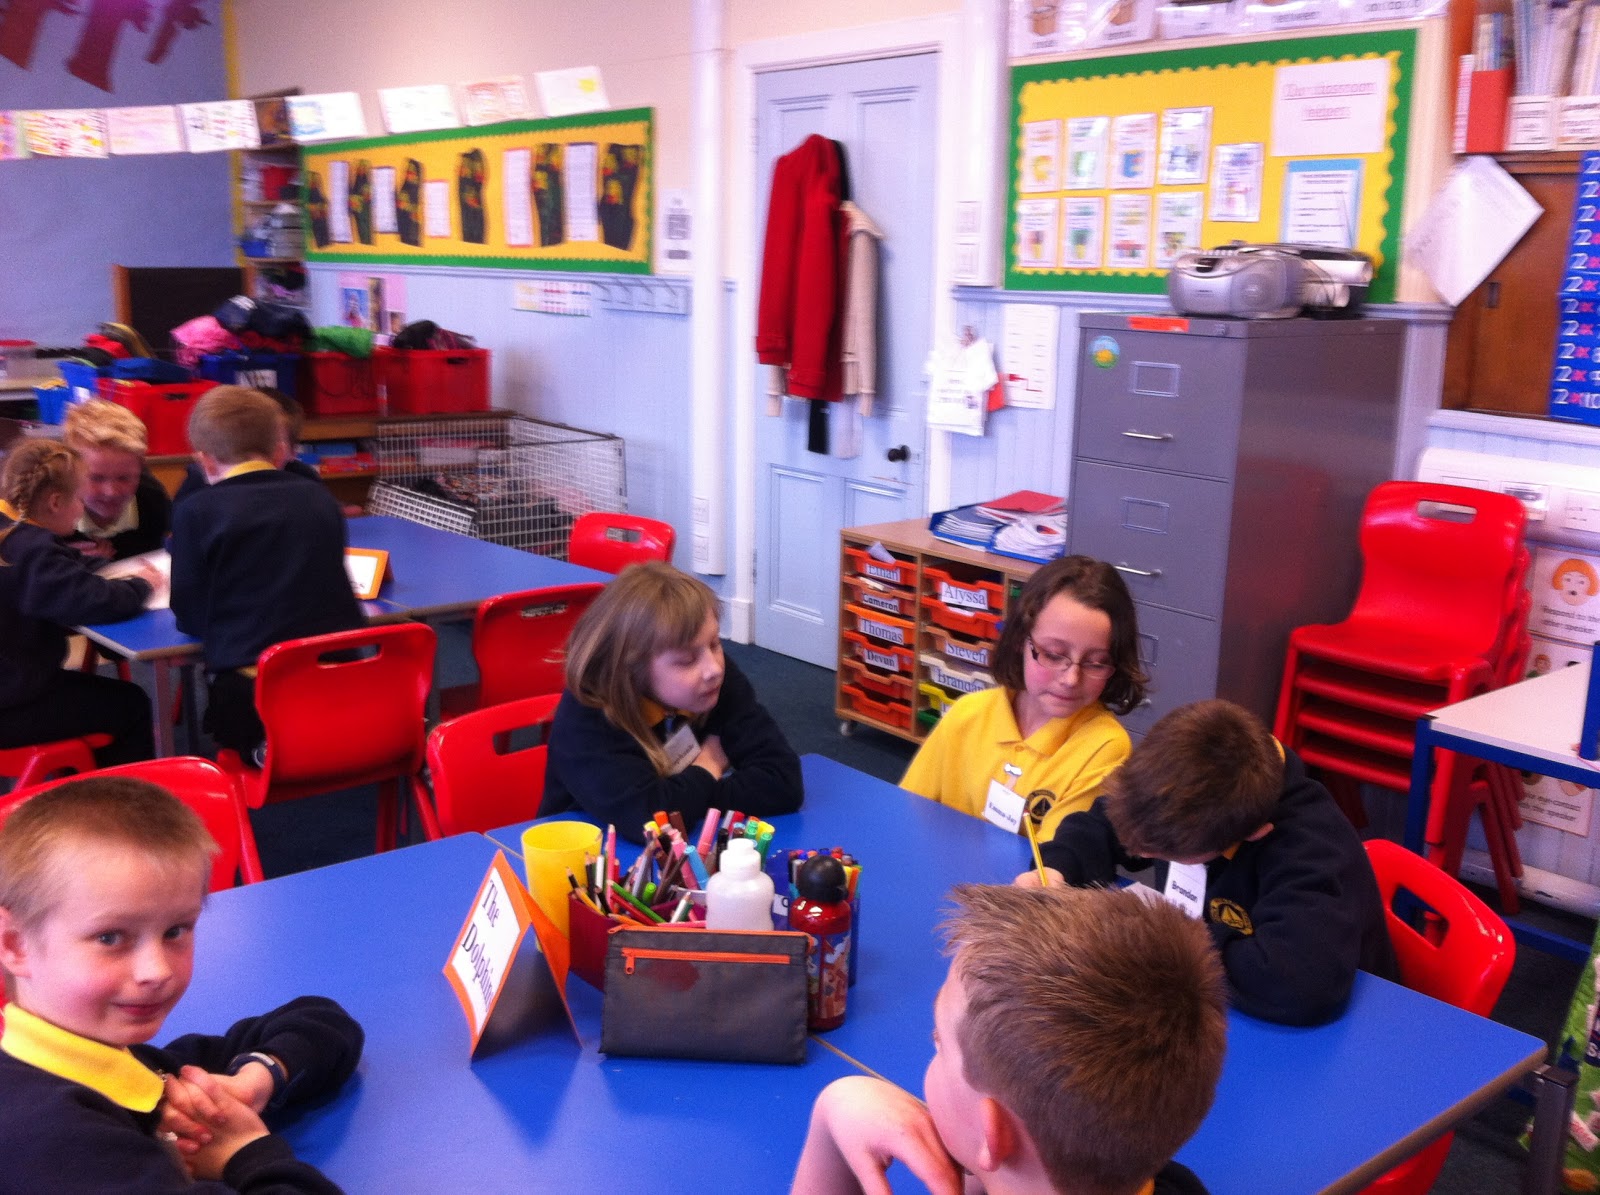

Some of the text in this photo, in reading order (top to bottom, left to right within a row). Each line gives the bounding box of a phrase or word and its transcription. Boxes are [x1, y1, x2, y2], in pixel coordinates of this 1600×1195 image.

[863, 593, 898, 612] Cameron
[945, 585, 986, 604] Alyssa
[861, 619, 903, 643] Thomas
[482, 879, 500, 928] The
[462, 923, 495, 1013] Dolphin
